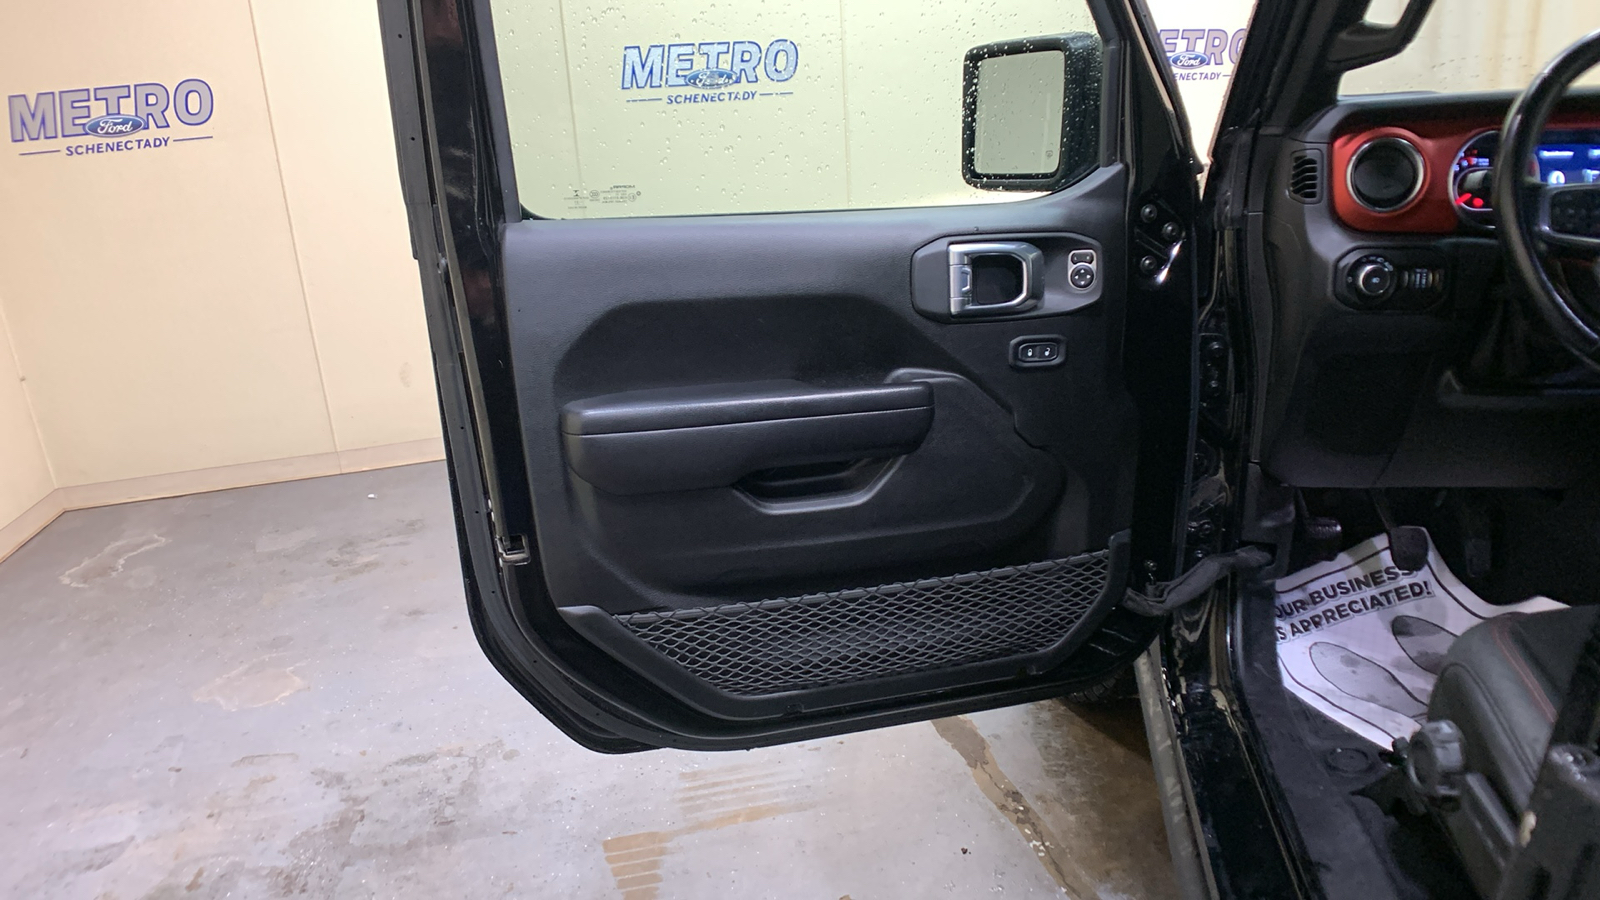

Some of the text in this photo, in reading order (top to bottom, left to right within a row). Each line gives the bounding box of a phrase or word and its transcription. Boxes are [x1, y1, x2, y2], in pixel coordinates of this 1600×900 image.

[621, 39, 799, 90] METRO
[1177, 54, 1202, 66] Ford
[667, 91, 757, 104] SCHENECTADY
[8, 79, 214, 143] METRO
[97, 118, 133, 134] Ford
[65, 136, 171, 156] SCHENECTADY
[1290, 580, 1432, 637] APPRECIATED!
